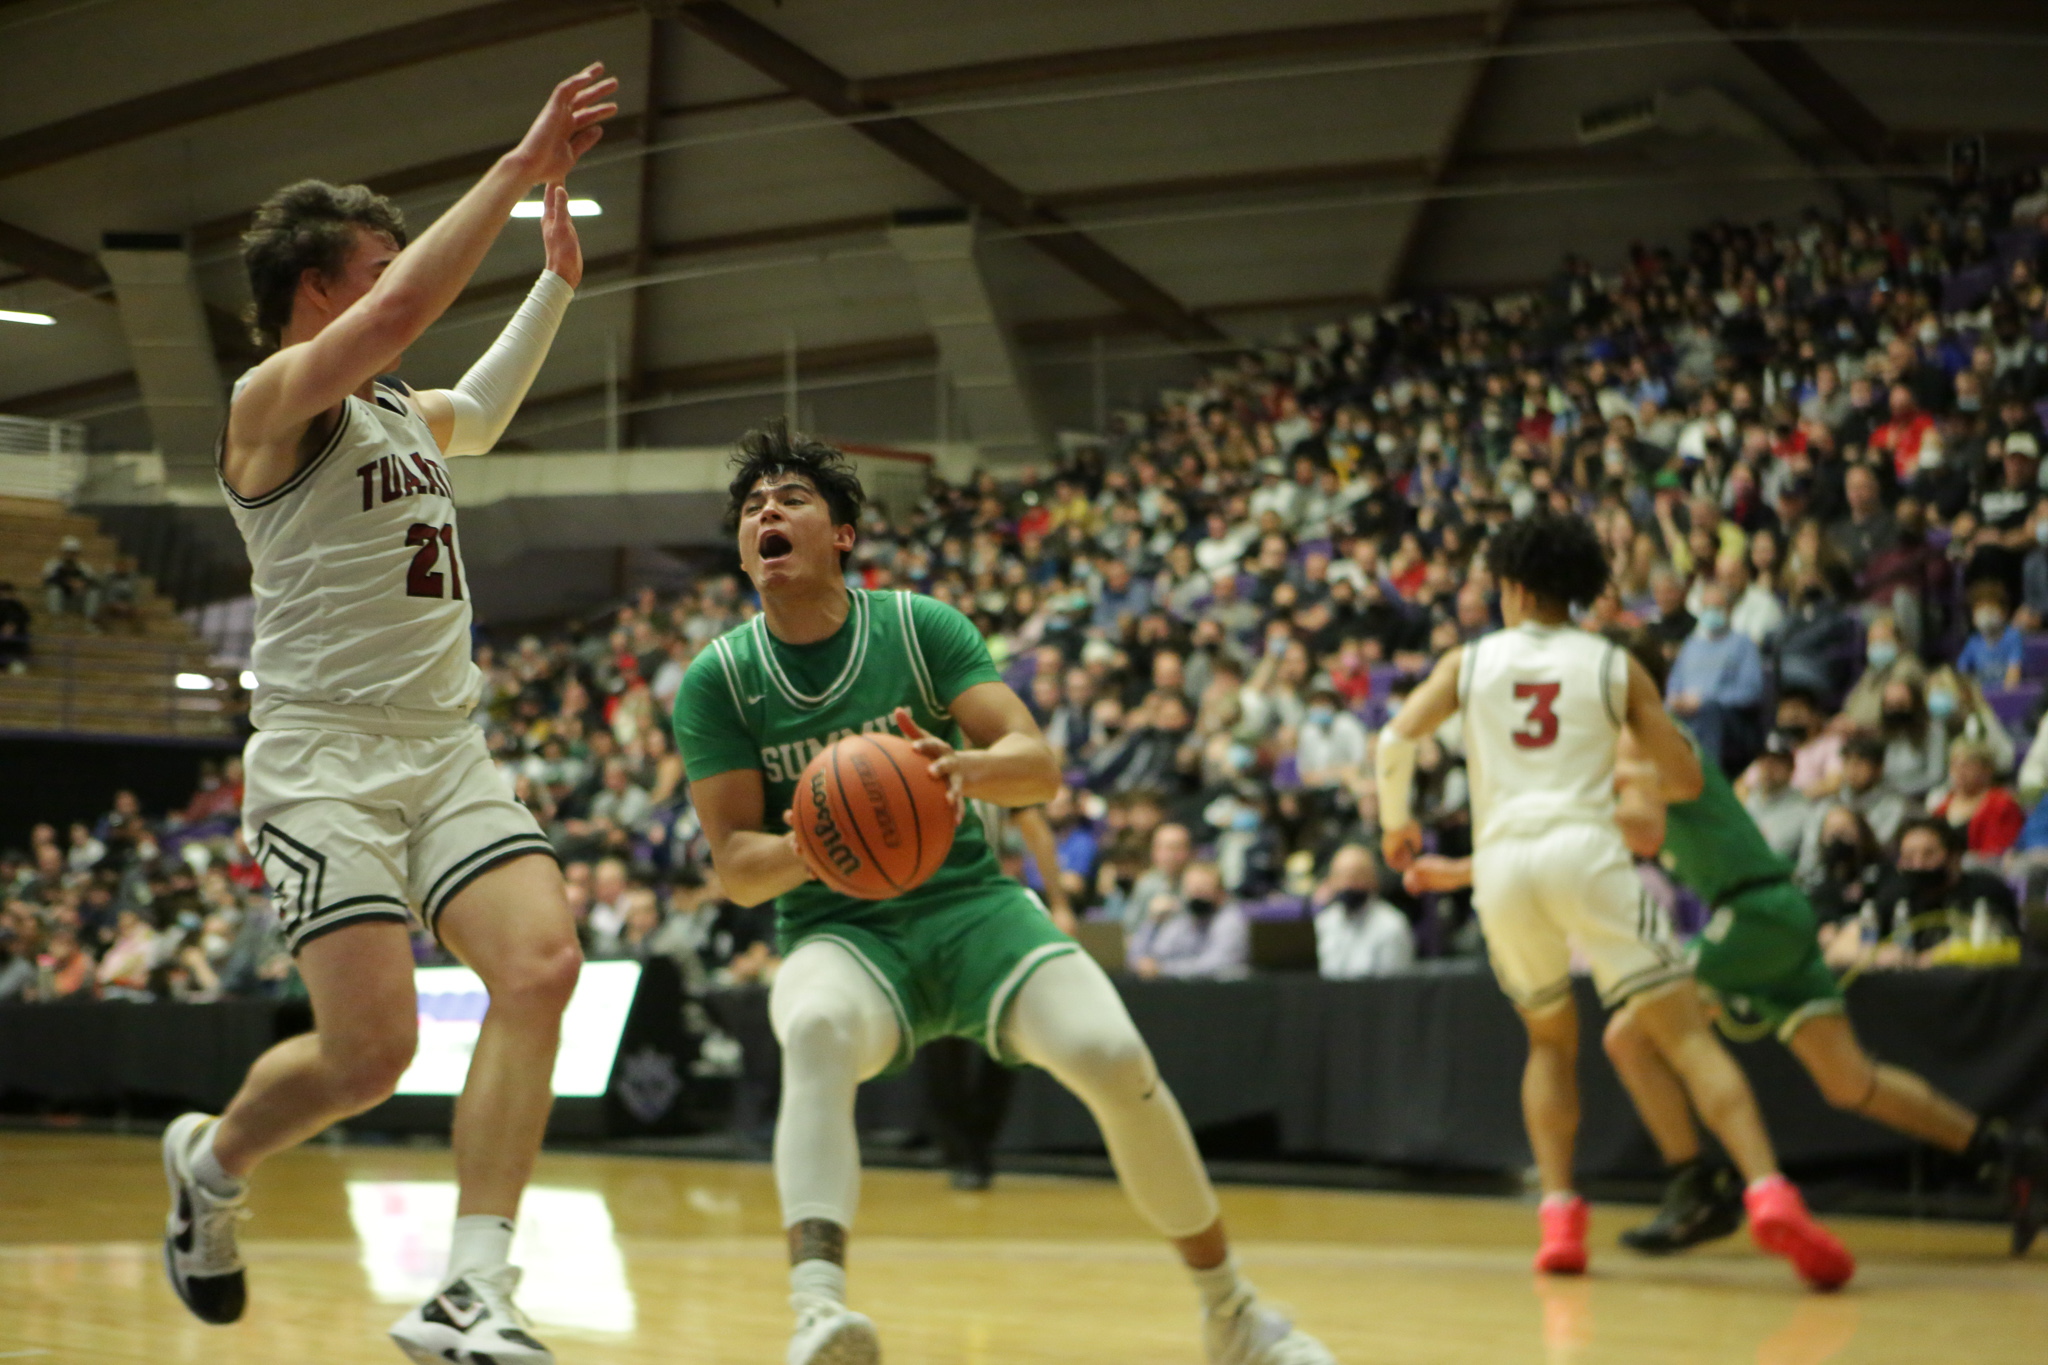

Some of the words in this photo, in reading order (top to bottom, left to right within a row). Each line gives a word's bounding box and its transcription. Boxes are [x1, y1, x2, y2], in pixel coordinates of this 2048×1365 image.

[405, 523, 464, 601] 21
[1512, 681, 1561, 750] 3
[811, 767, 861, 876] Wilson
